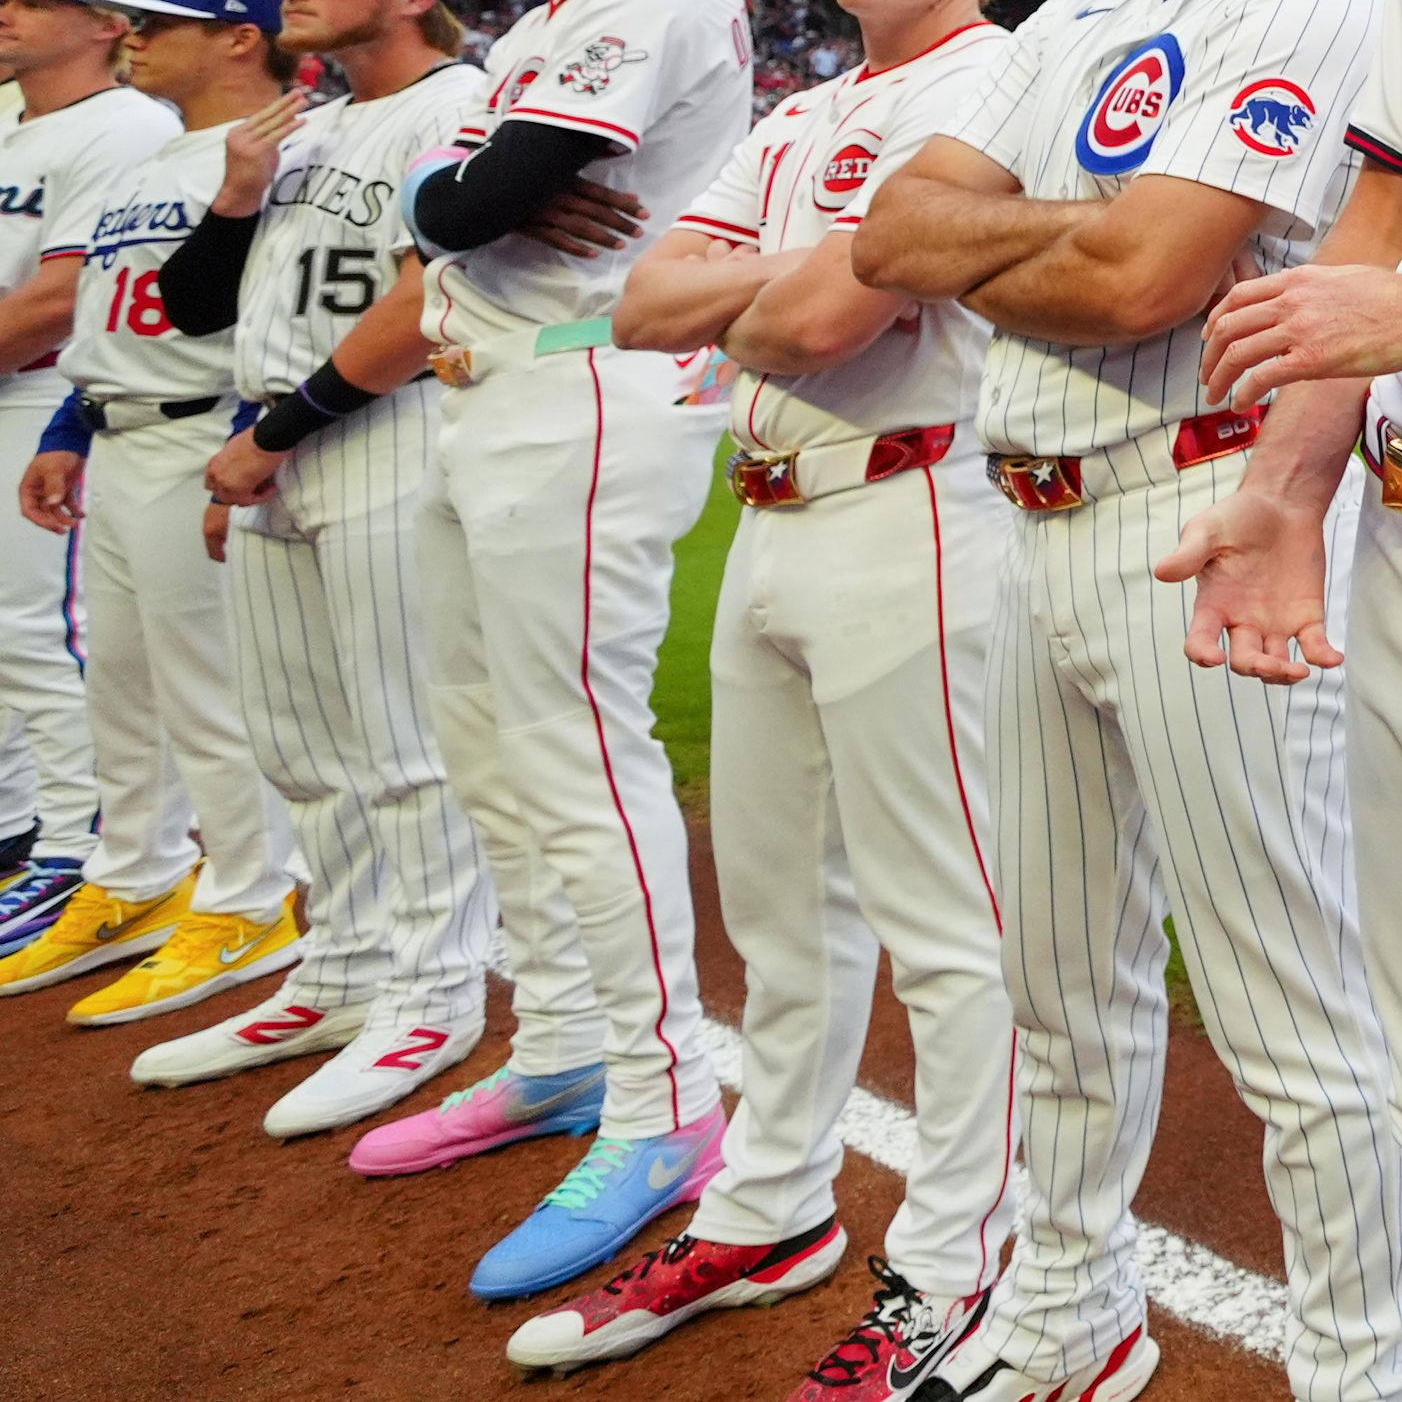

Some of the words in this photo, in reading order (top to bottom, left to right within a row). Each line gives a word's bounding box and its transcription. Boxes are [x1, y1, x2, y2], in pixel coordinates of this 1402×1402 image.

[1093, 56, 1163, 148] CUBS
[270, 164, 394, 227] CKIES
[823, 158, 874, 181] RED
[106, 265, 174, 337] 18
[295, 248, 376, 316] 15
